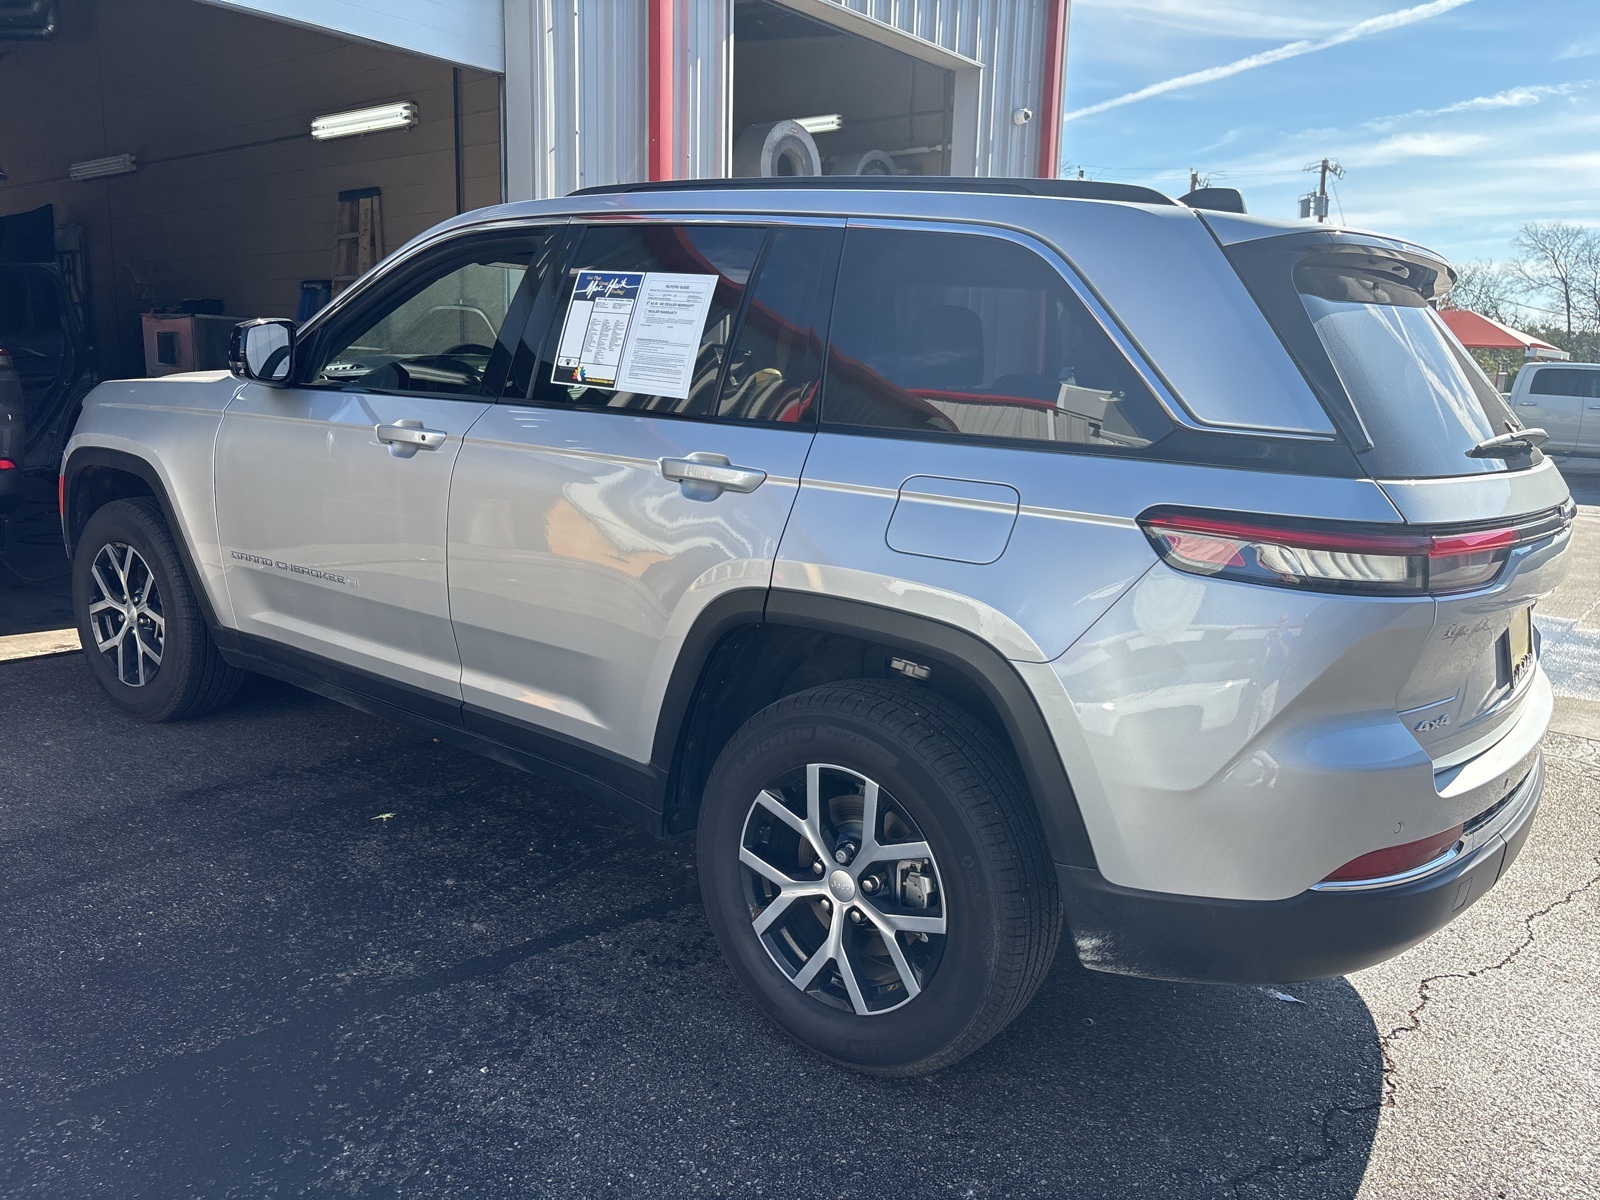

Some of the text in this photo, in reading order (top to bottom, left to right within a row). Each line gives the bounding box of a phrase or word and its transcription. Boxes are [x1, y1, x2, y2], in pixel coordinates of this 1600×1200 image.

[230, 551, 346, 585] GRAND CHEROKEE
[745, 727, 872, 763] MICHELIN PRIMACY
[831, 880, 851, 891] Jeep
